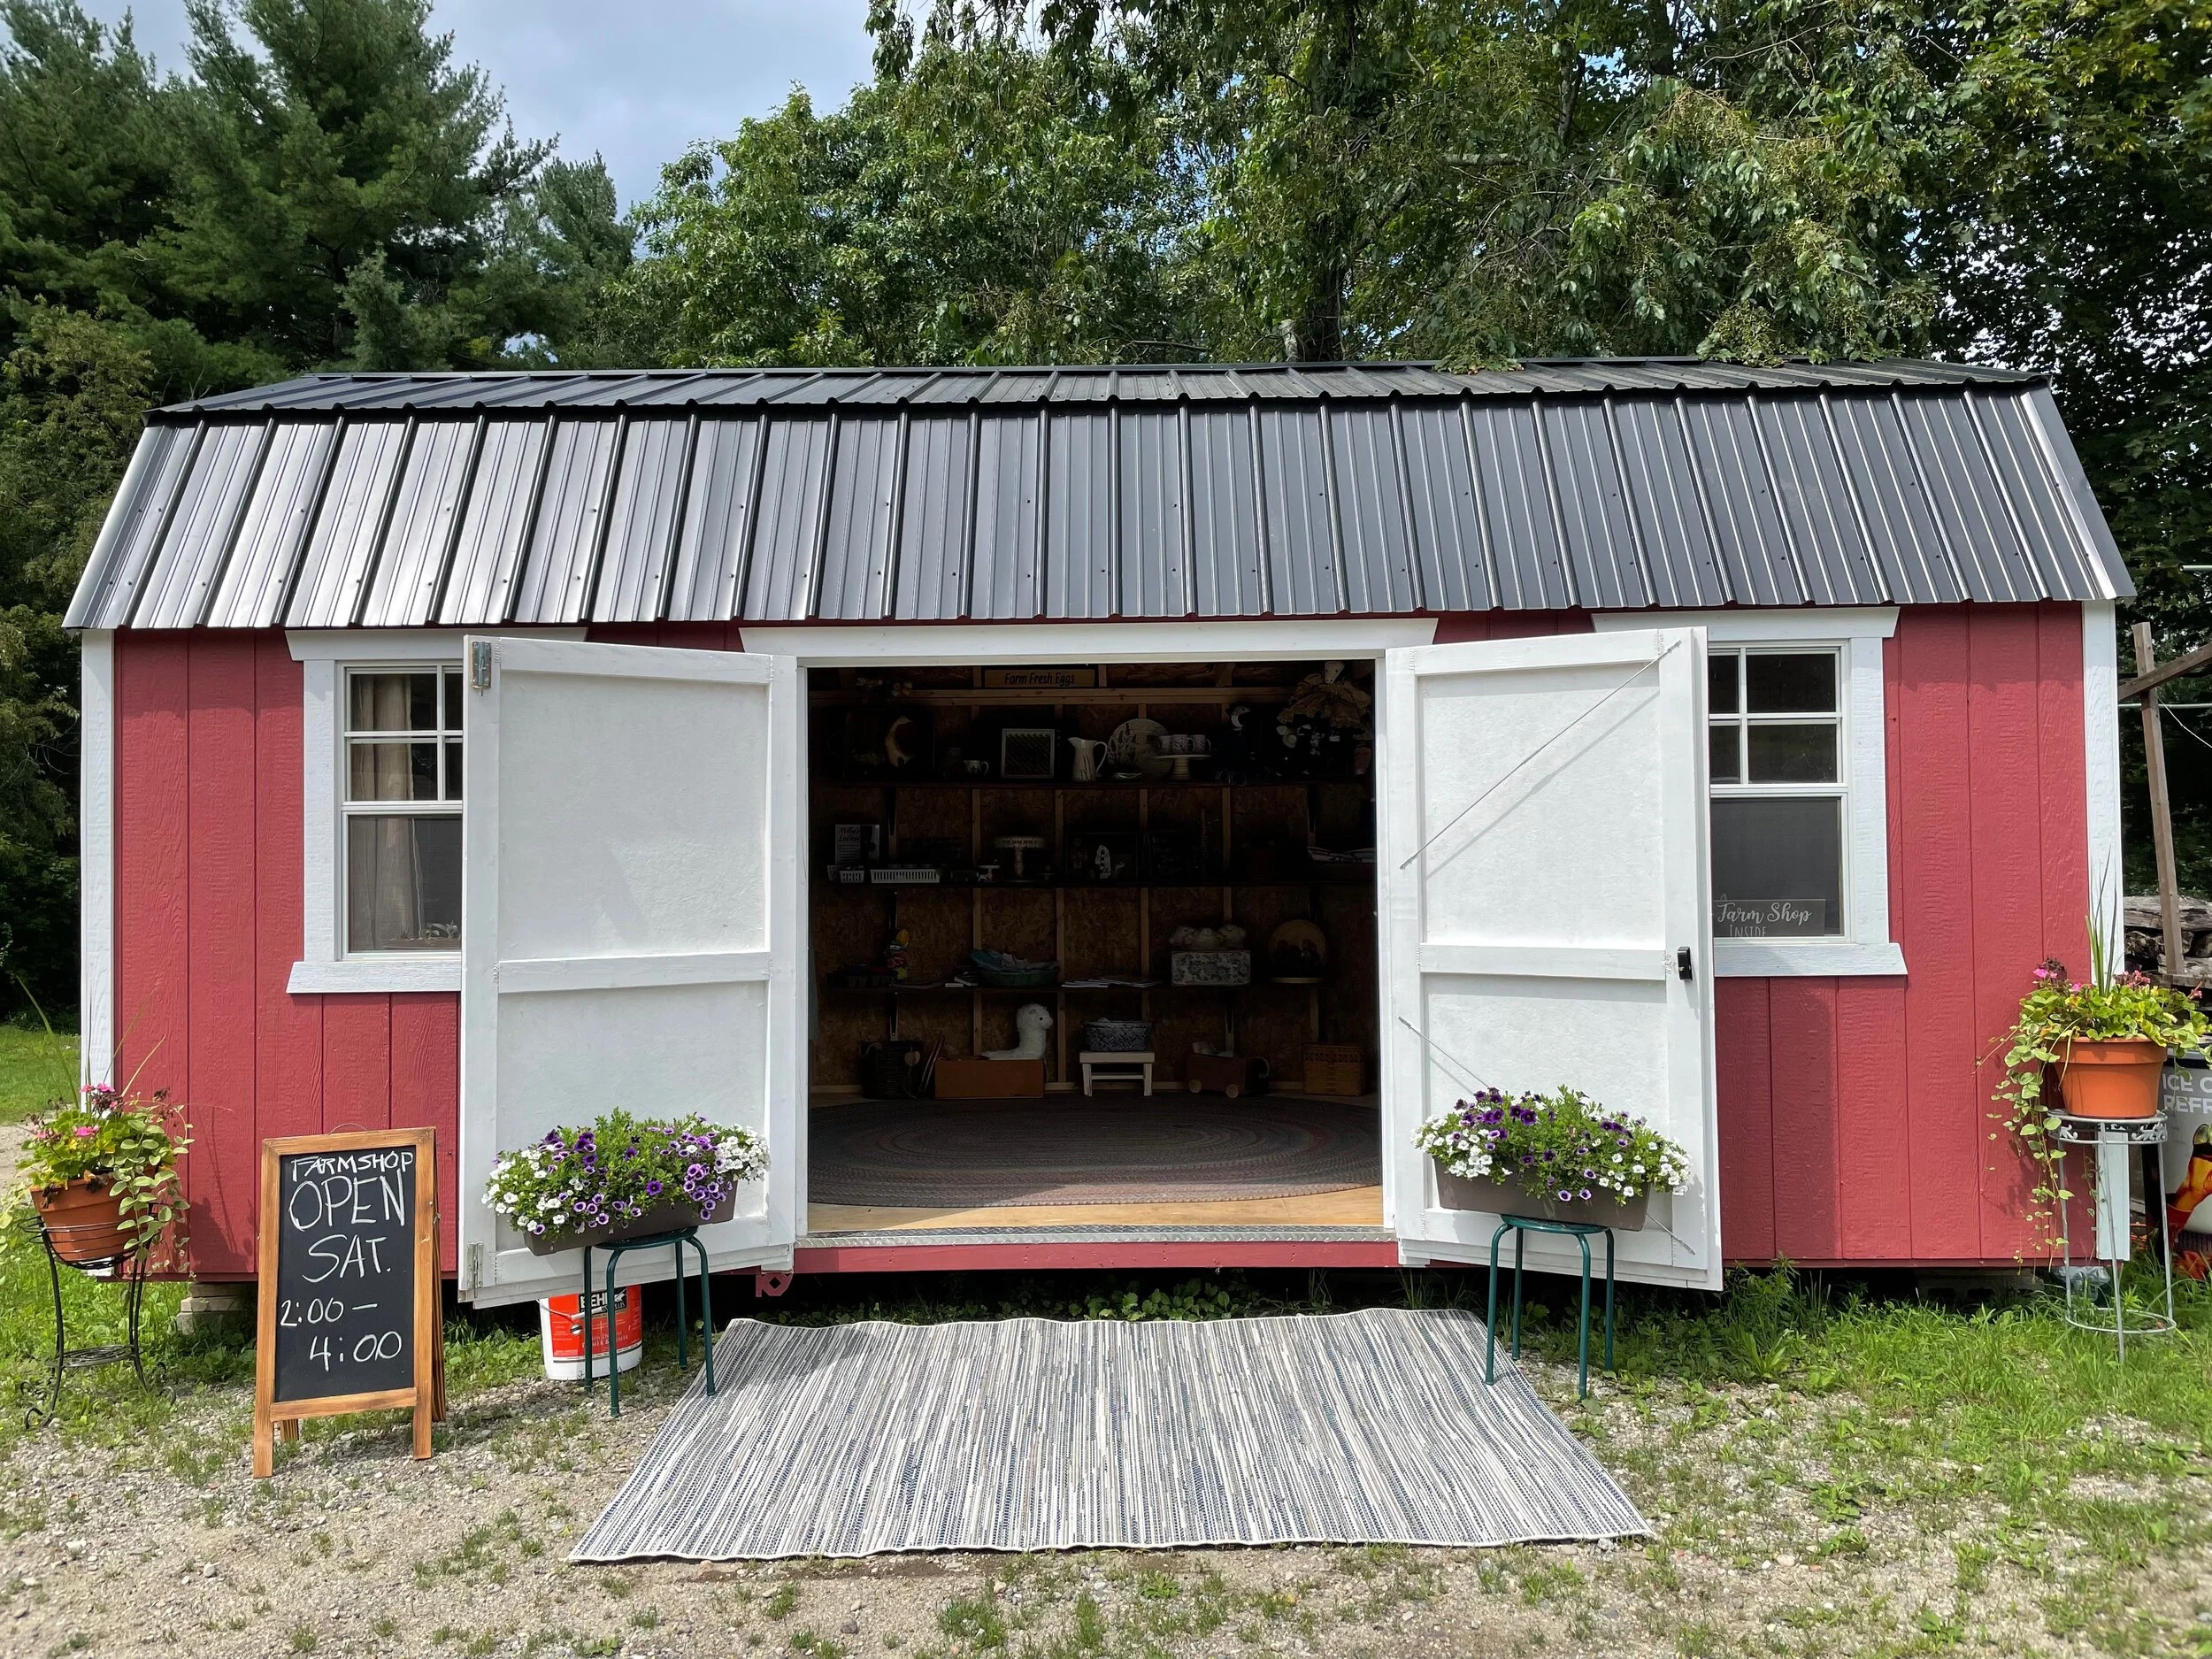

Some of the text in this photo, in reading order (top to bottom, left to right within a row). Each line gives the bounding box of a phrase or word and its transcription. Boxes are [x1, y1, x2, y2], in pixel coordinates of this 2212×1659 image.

[1004, 672, 1075, 686] Farm Fresh Eggs
[1717, 902, 1812, 926] Farm Shop
[2162, 1073, 2193, 1092] ICE
[290, 1150, 414, 1183] FARMSHOP
[288, 1168, 406, 1232] OPEN
[302, 1233, 392, 1283] SAT.
[280, 1297, 344, 1327] 2:00
[310, 1331, 402, 1371] 4:00
